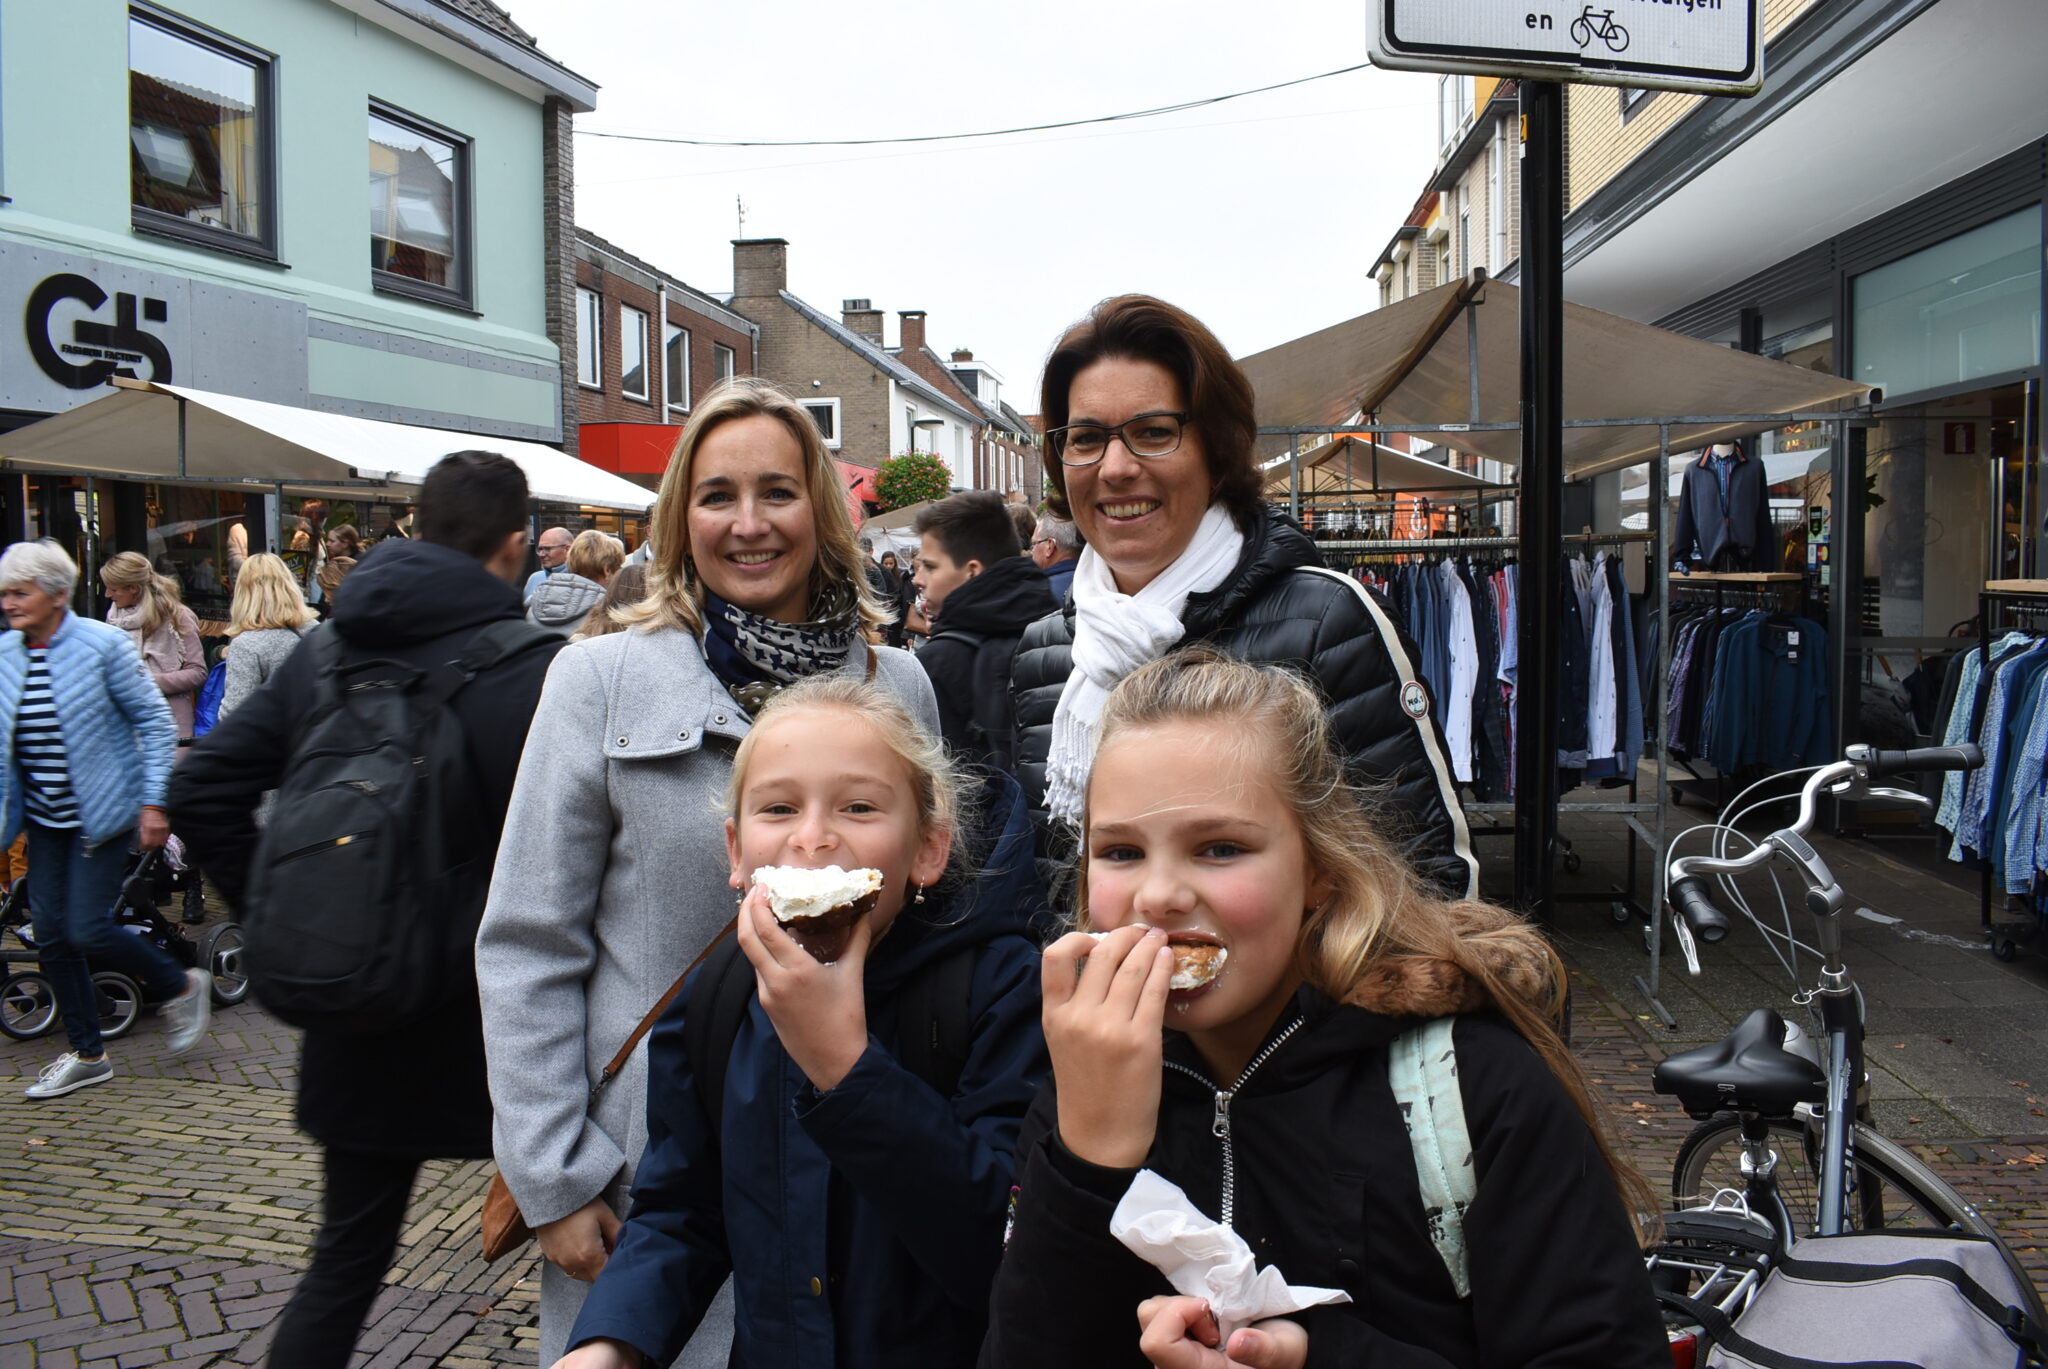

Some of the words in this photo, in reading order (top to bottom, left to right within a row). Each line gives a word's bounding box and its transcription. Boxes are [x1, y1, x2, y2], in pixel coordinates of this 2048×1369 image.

[1525, 13, 1553, 30] en
[61, 343, 103, 358] FASHION
[103, 349, 144, 363] FACTORY
